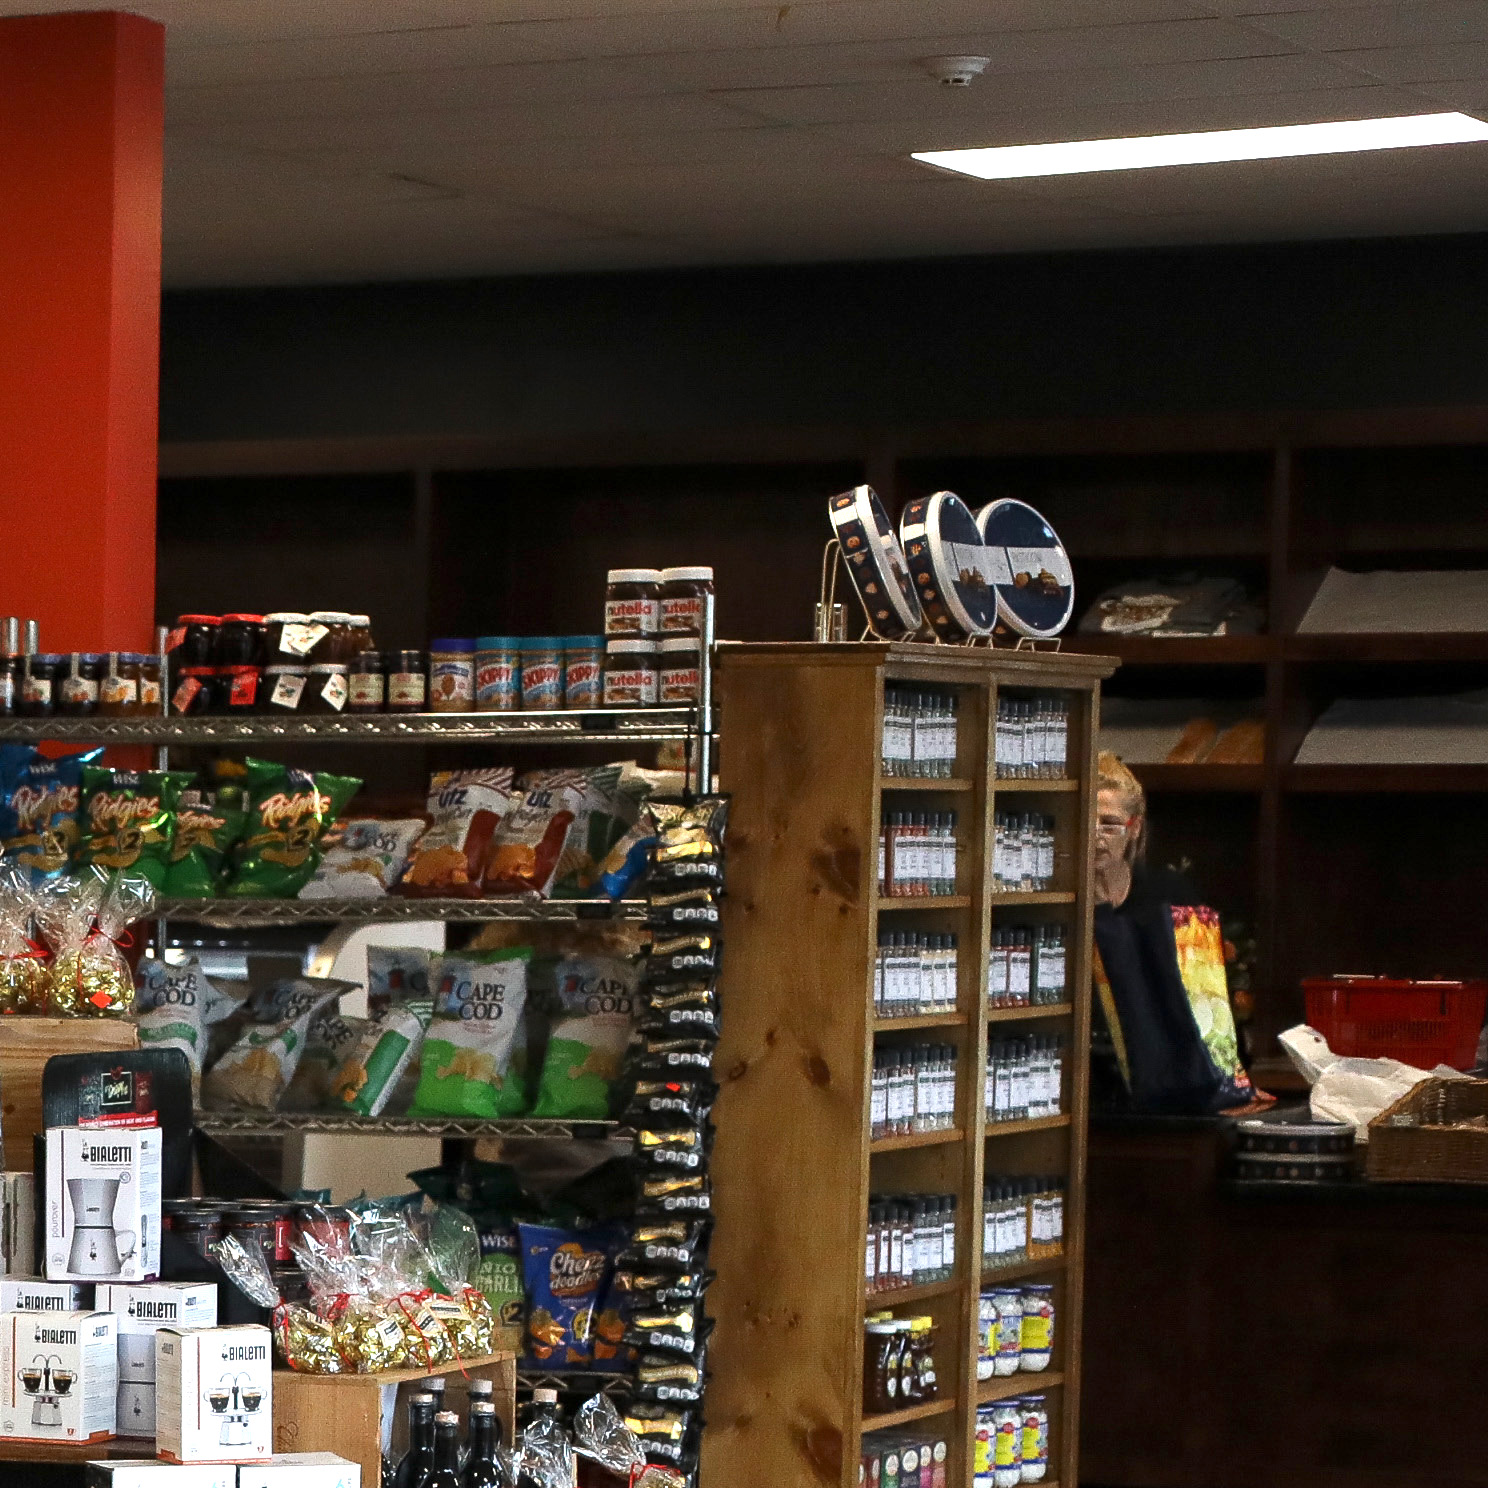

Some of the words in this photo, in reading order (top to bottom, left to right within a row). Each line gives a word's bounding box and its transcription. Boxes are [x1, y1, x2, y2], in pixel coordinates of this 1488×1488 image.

[607, 601, 653, 616] nutella
[477, 666, 512, 689] SKIPPY
[523, 667, 561, 689] SKIPPY
[607, 672, 653, 687] nutella
[89, 795, 159, 834] Ridgies
[147, 972, 199, 993] CAPE
[456, 981, 506, 1002] CAPE
[152, 988, 197, 1007] COD
[584, 996, 634, 1016] COD
[458, 1001, 503, 1021] COD
[90, 1145, 132, 1163] BIALETTI
[51, 1200, 62, 1238] pourover
[24, 1295, 64, 1310] BIALETTI
[136, 1301, 177, 1319] BIALETTI
[41, 1329, 77, 1345] BIALETTI
[229, 1345, 266, 1361] BIALETTI
